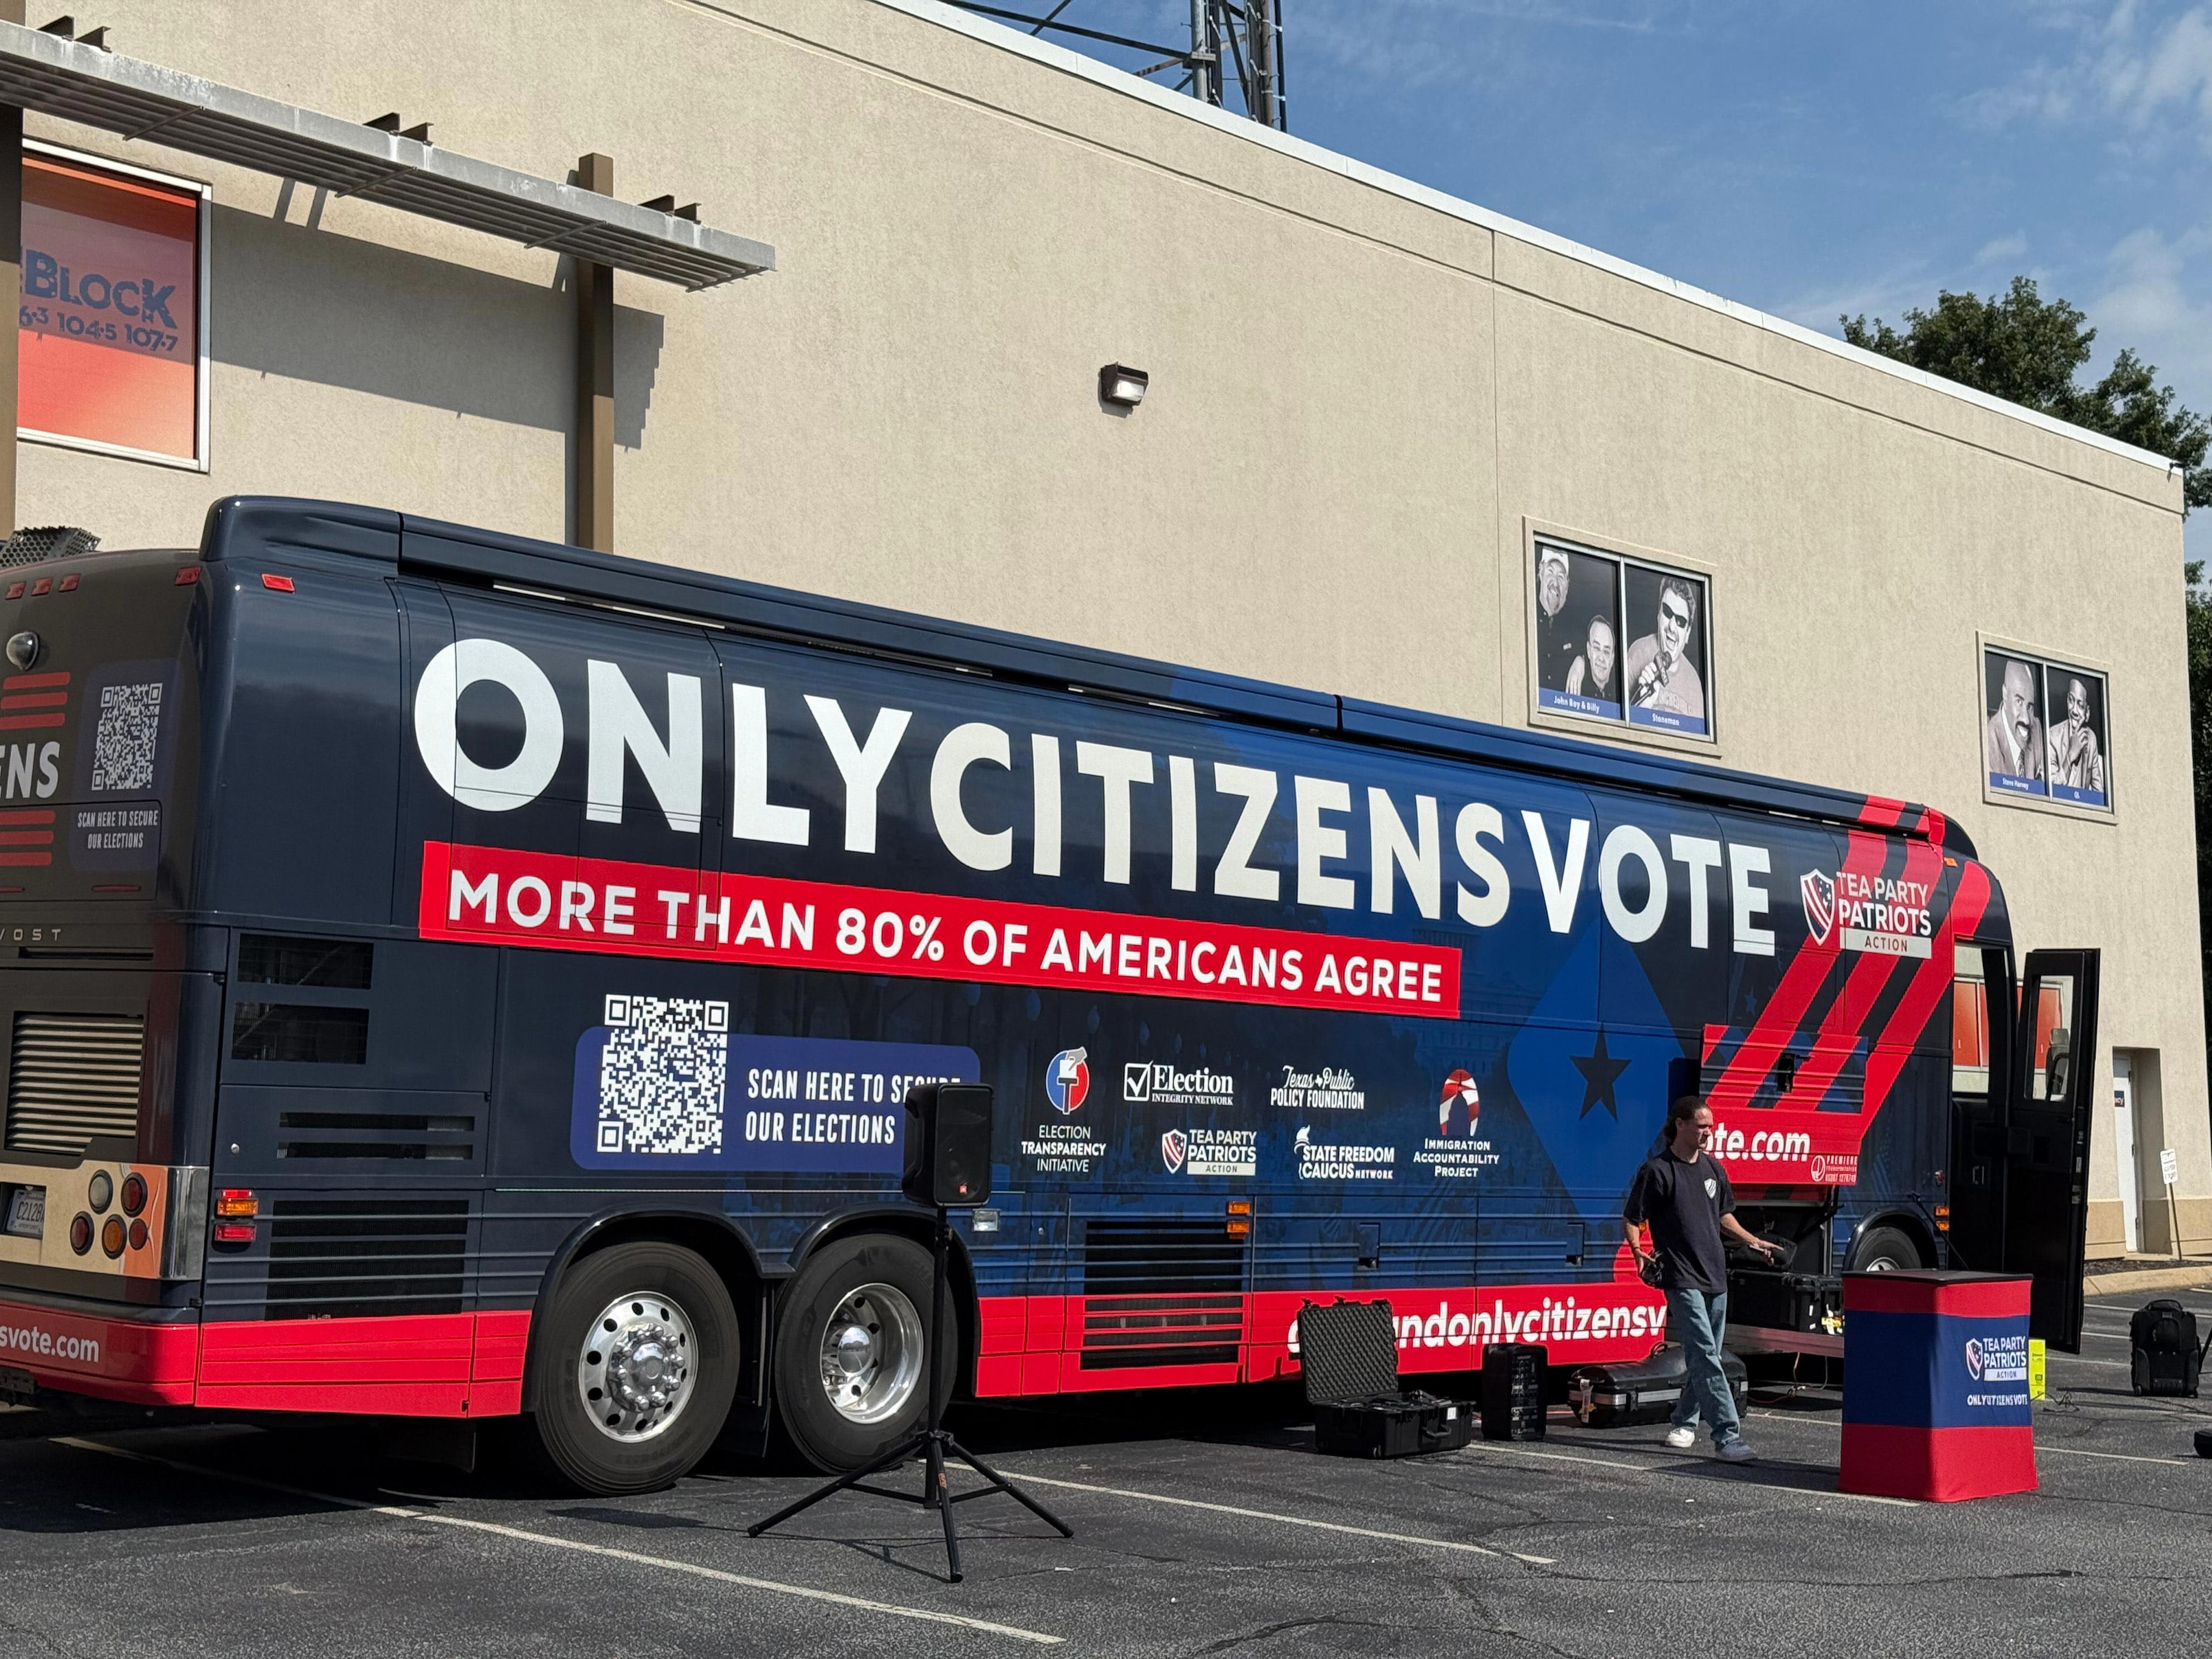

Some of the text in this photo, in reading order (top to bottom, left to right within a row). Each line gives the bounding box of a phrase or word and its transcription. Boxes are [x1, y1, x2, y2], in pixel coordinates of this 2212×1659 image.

[1554, 695, 1568, 706] John
[1587, 702, 1600, 714] Billy
[1652, 713, 1680, 726] Stoneman
[0, 741, 60, 799] NS
[78, 810, 158, 828] SCAN HERE TO SECURE
[88, 832, 143, 849] OUR ELECTIONS
[1836, 871, 1929, 906] TEA PARTY
[1838, 898, 1932, 937] PATRIOTS
[449, 870, 1442, 1002] MORE THAN 80% OF AMERICANS AGREE
[1864, 935, 1907, 952] ACTION
[748, 1068, 798, 1099] SCAN
[805, 1071, 855, 1101] HERE
[861, 1074, 884, 1103] TO
[1152, 1064, 1234, 1094] Election
[1283, 1065, 1355, 1091] Texas Public
[1151, 1093, 1233, 1106] INTEGRITY NETWORK
[1270, 1088, 1365, 1110] POLICY FOUNDATION
[745, 1111, 895, 1144] OUR ELECTIONS
[1039, 1125, 1091, 1139] ELECTION
[1189, 1129, 1257, 1145] TEA PARTY
[1424, 1137, 1490, 1151] IMMIGRATION
[1021, 1141, 1106, 1156] TRANSPARENCY
[1187, 1145, 1257, 1163] PATRIOTS
[1303, 1145, 1395, 1163] STATE FREEDOM
[1037, 1159, 1090, 1173] INITIATIVE
[1413, 1151, 1500, 1165] ACCOUNTABILITY
[1302, 1162, 1394, 1180] CAUCUS NETWORK
[1434, 1165, 1478, 1178] PROJECT
[1983, 1336, 2026, 1351] TEA PARTY
[1984, 1351, 2027, 1368] PATRIOTS
